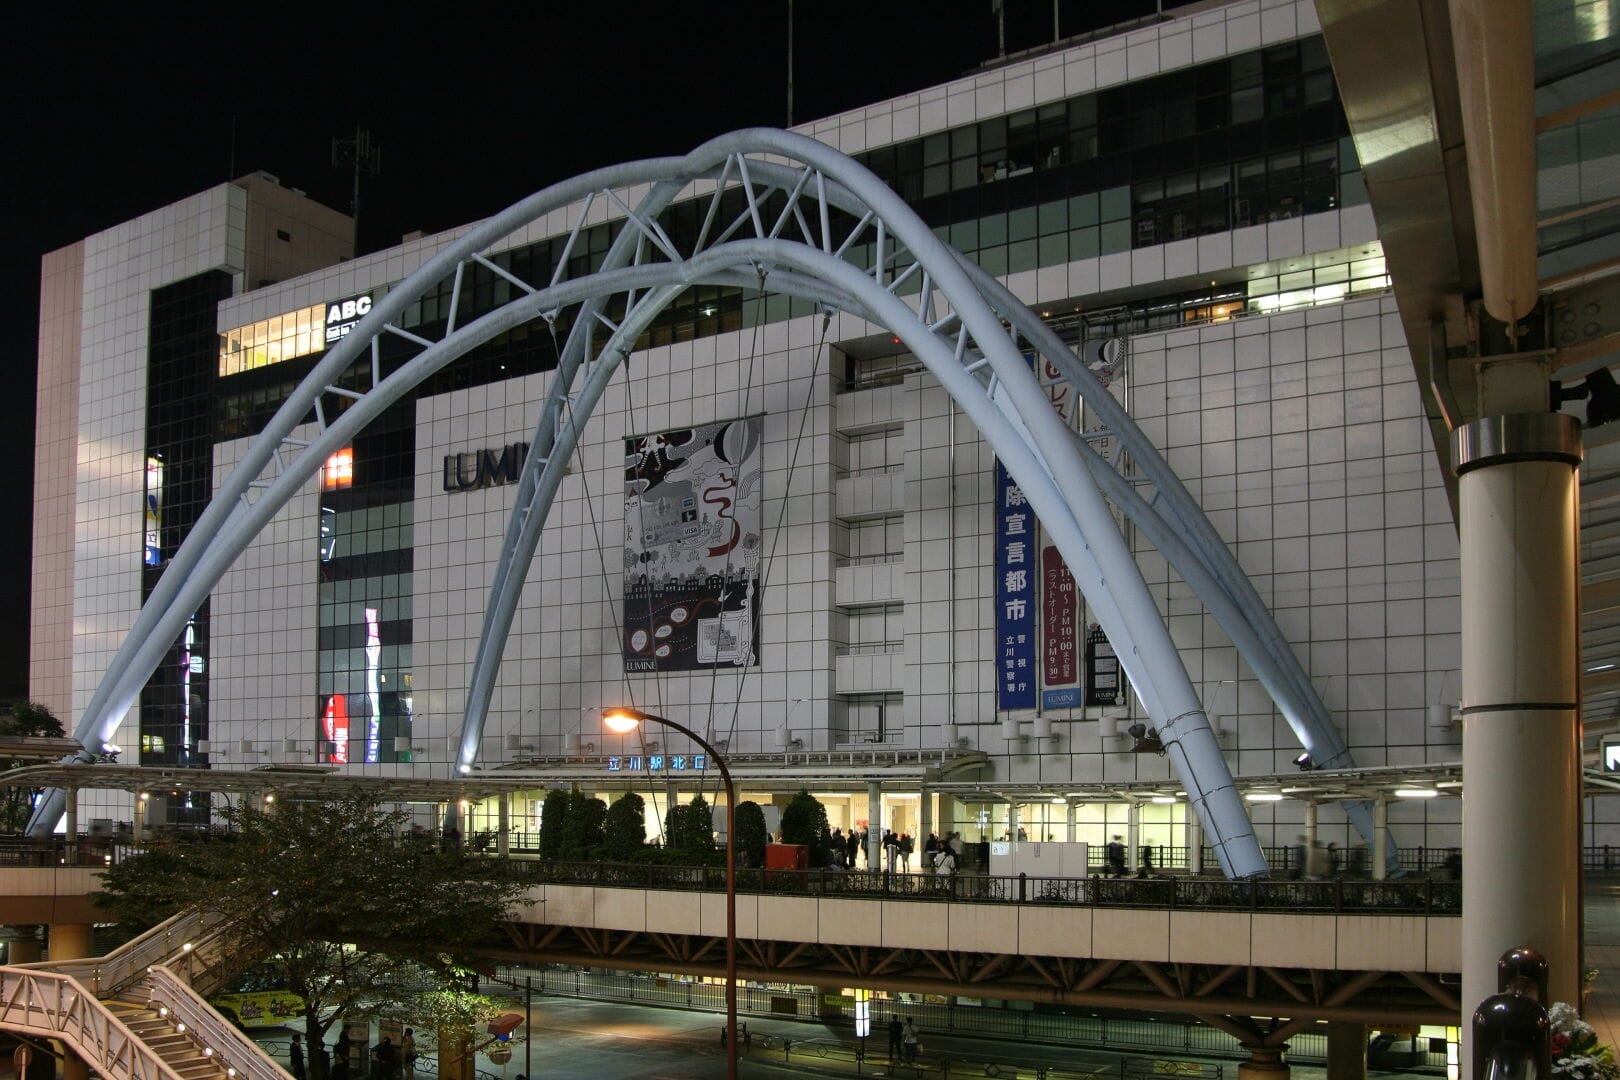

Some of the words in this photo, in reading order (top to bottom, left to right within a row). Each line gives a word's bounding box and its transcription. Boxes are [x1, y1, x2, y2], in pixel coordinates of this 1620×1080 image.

[327, 296, 372, 324] ABC
[684, 527, 699, 535] VISA
[1005, 472, 1027, 620] 除宣言都市
[626, 661, 656, 671] LUMINE
[1017, 634, 1027, 692] 警視庁
[608, 755, 706, 771] 立川駅北口
